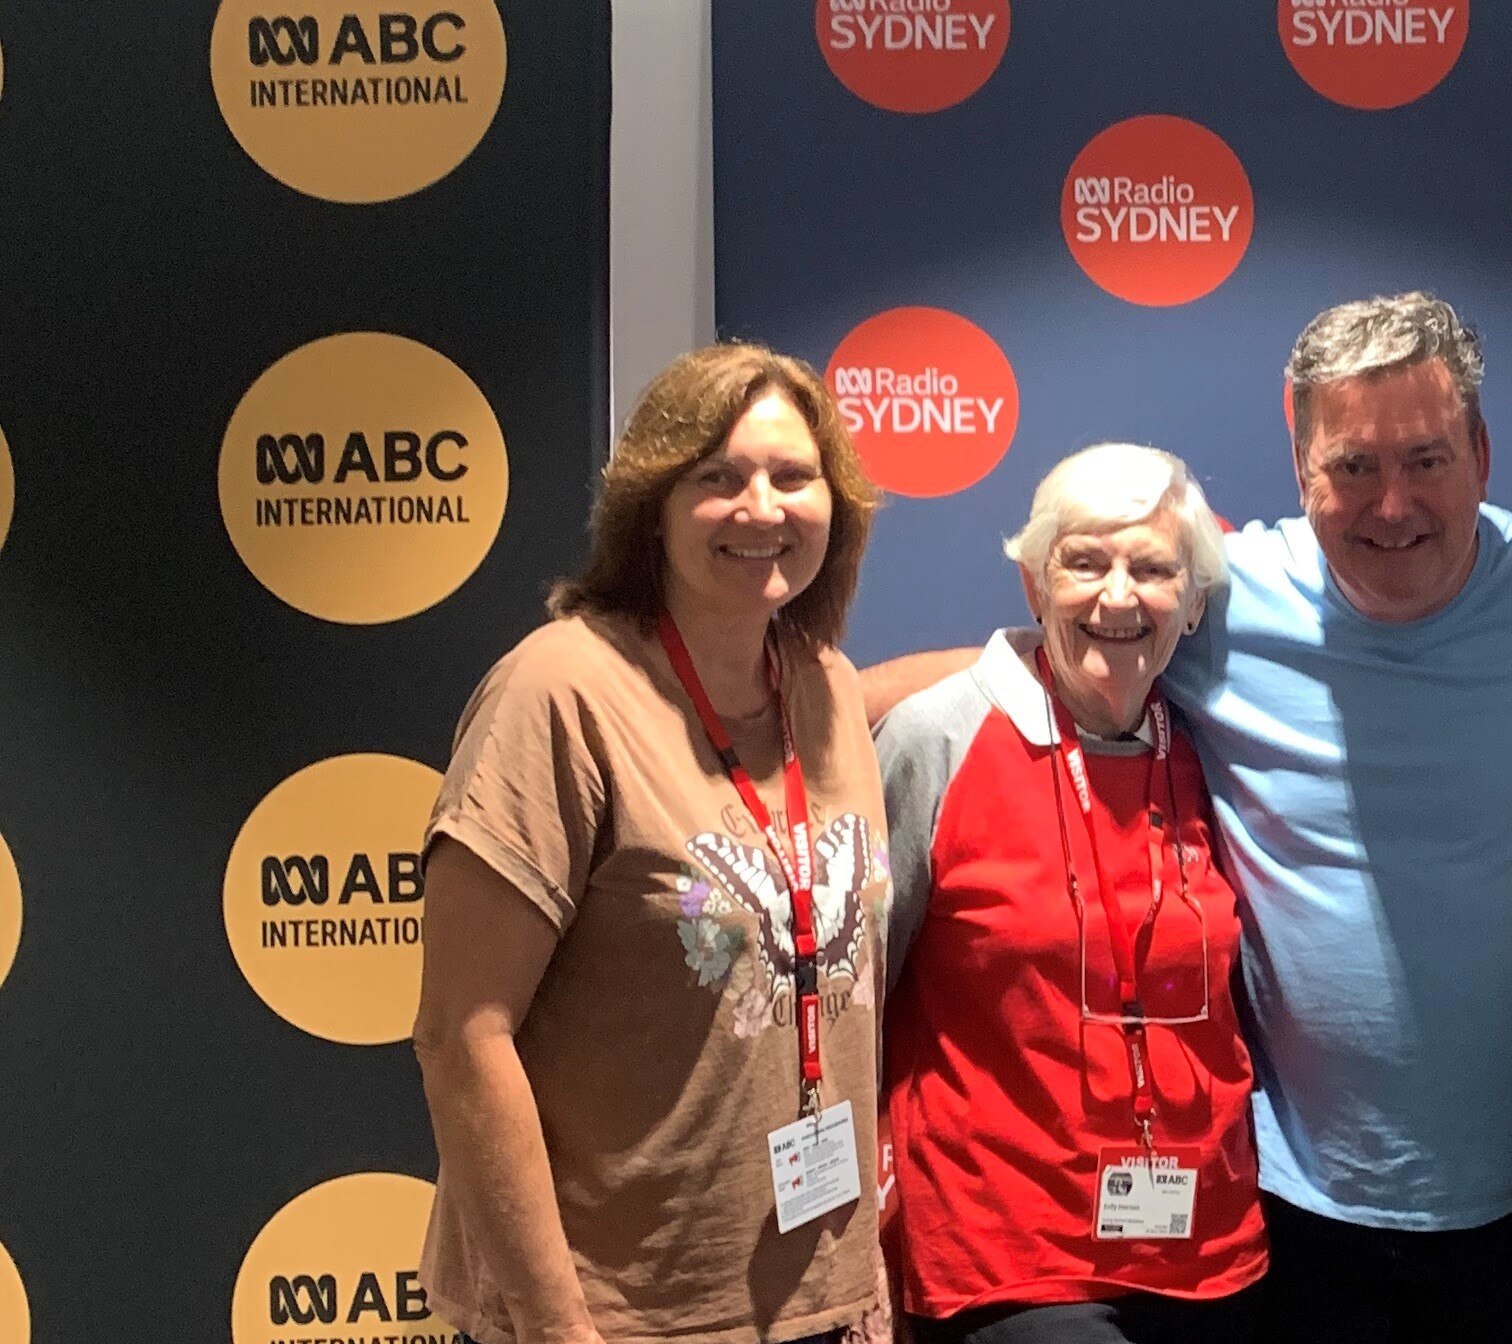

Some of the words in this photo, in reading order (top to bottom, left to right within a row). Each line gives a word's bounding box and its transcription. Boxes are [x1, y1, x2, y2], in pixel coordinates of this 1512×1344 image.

[329, 12, 467, 65] ABC
[829, 14, 995, 51] SYDNEY
[1291, 8, 1455, 46] SYDNEY
[250, 77, 468, 108] INTERNATIONAL
[1113, 176, 1195, 205] Radio
[1075, 205, 1239, 243] SYDNEY
[876, 367, 958, 397] Radio
[841, 398, 1003, 434] SYDNEY
[335, 430, 468, 483] ABC
[256, 494, 470, 526] INTERNATIONAL
[1066, 747, 1091, 814] VISITOR
[793, 821, 812, 891] VISITOR
[338, 853, 426, 905] AB
[261, 916, 425, 948] INTERNATIO
[1121, 1155, 1179, 1170] VISITOR
[346, 1270, 433, 1324] AB
